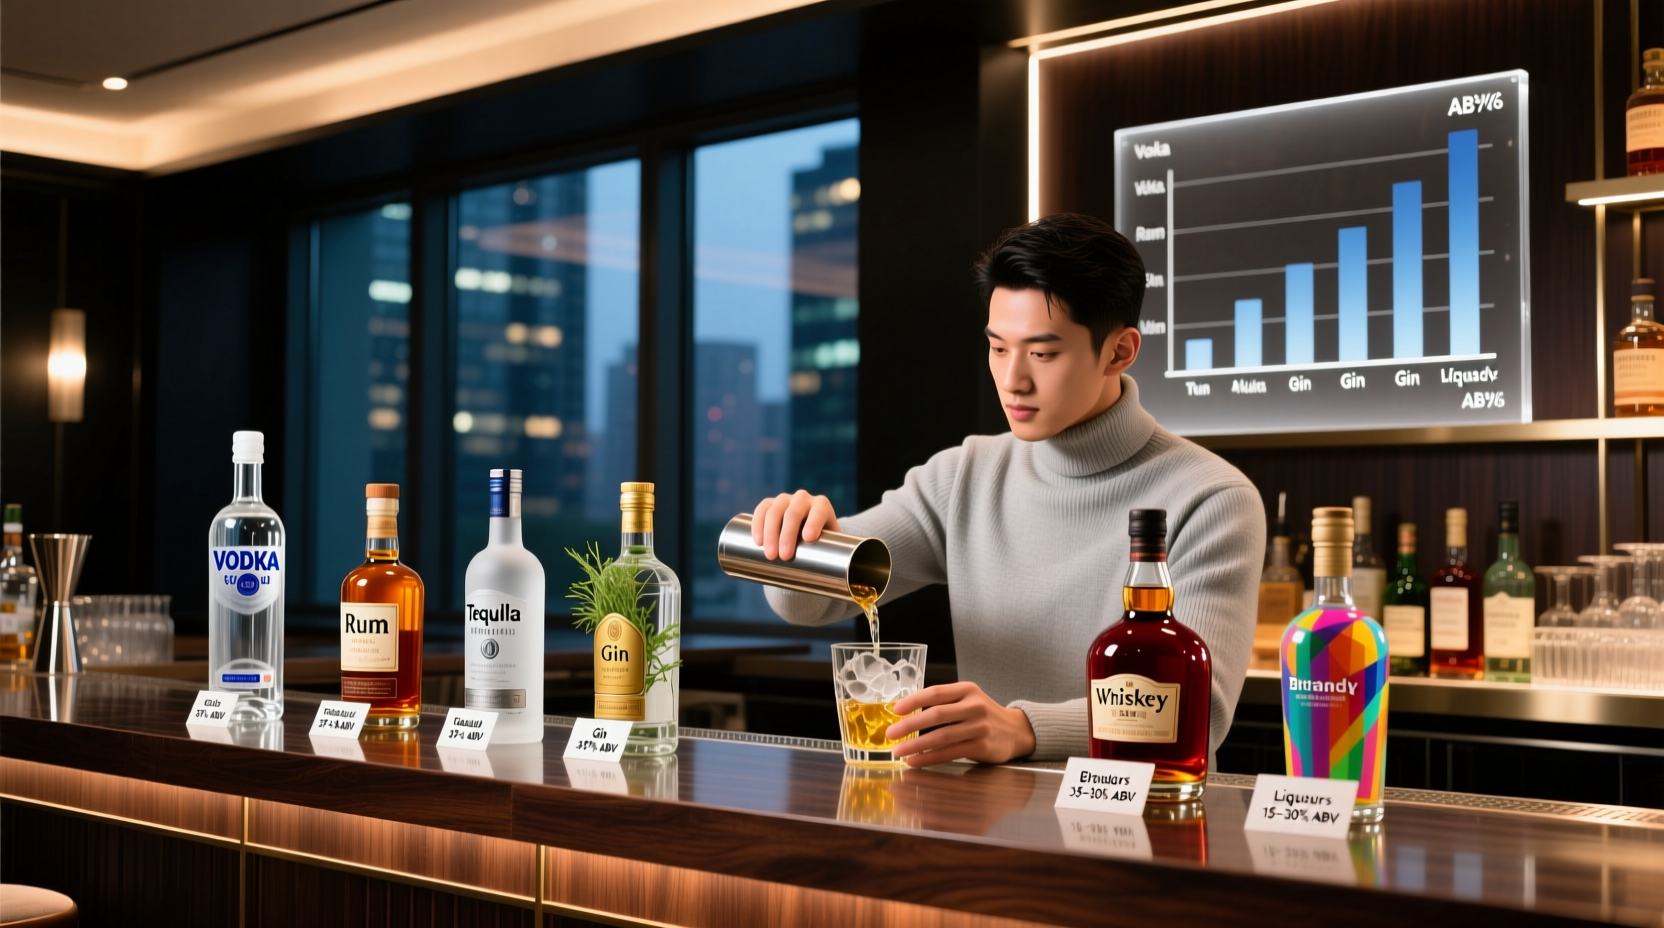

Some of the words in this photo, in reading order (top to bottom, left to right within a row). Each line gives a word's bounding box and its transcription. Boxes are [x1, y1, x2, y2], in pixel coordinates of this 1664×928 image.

[1288, 375, 1312, 392] Gin
[1340, 372, 1366, 389] Gin
[1394, 369, 1421, 387] Gin
[213, 550, 280, 571] VODKA
[345, 613, 390, 635] Rum
[601, 644, 630, 663] Gin
[1096, 687, 1169, 714] Whiskey
[1110, 790, 1137, 802] ABV
